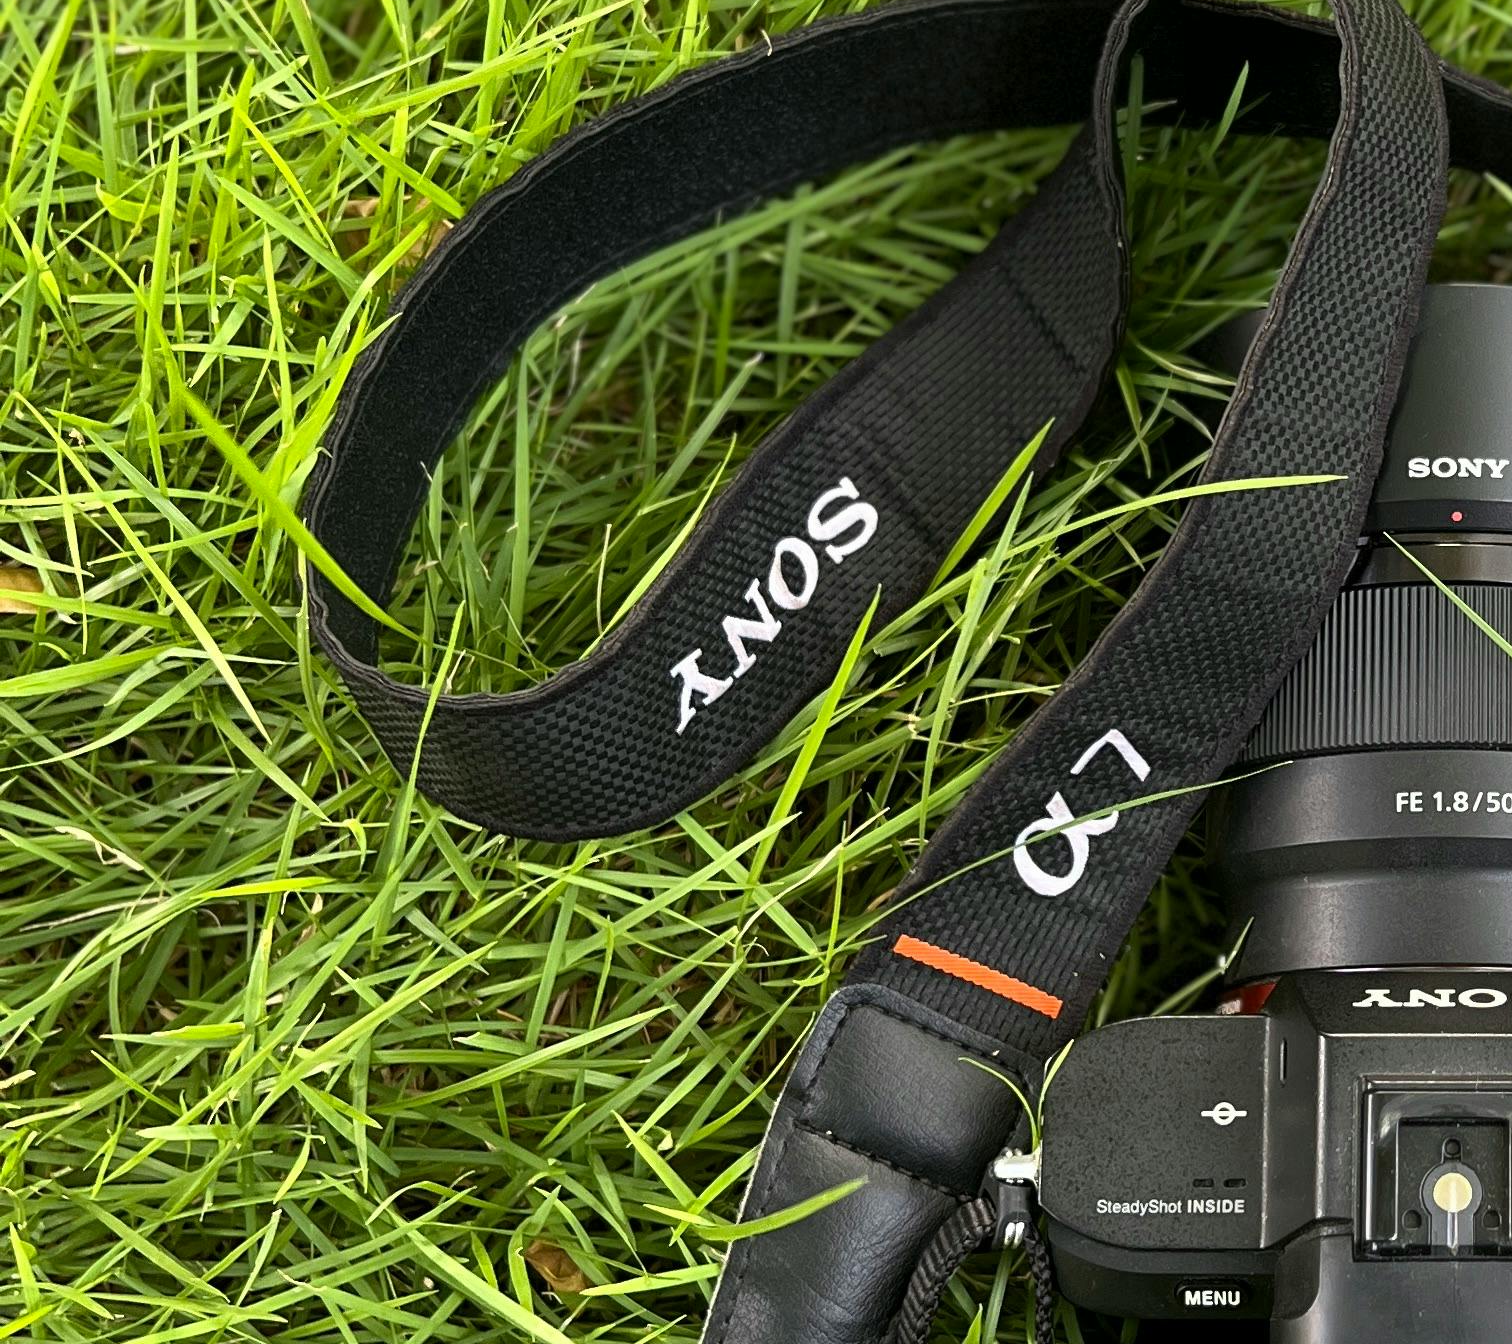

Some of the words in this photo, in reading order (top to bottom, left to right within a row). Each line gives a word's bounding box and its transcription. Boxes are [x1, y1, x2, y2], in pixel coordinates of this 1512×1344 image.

[1407, 457, 1510, 480] SONY
[670, 476, 880, 735] SONY
[1395, 791, 1423, 813] FE
[1096, 1199, 1183, 1217] SteadyShot
[1187, 1199, 1245, 1214] INSIDE
[1184, 1290, 1241, 1306] MENU
